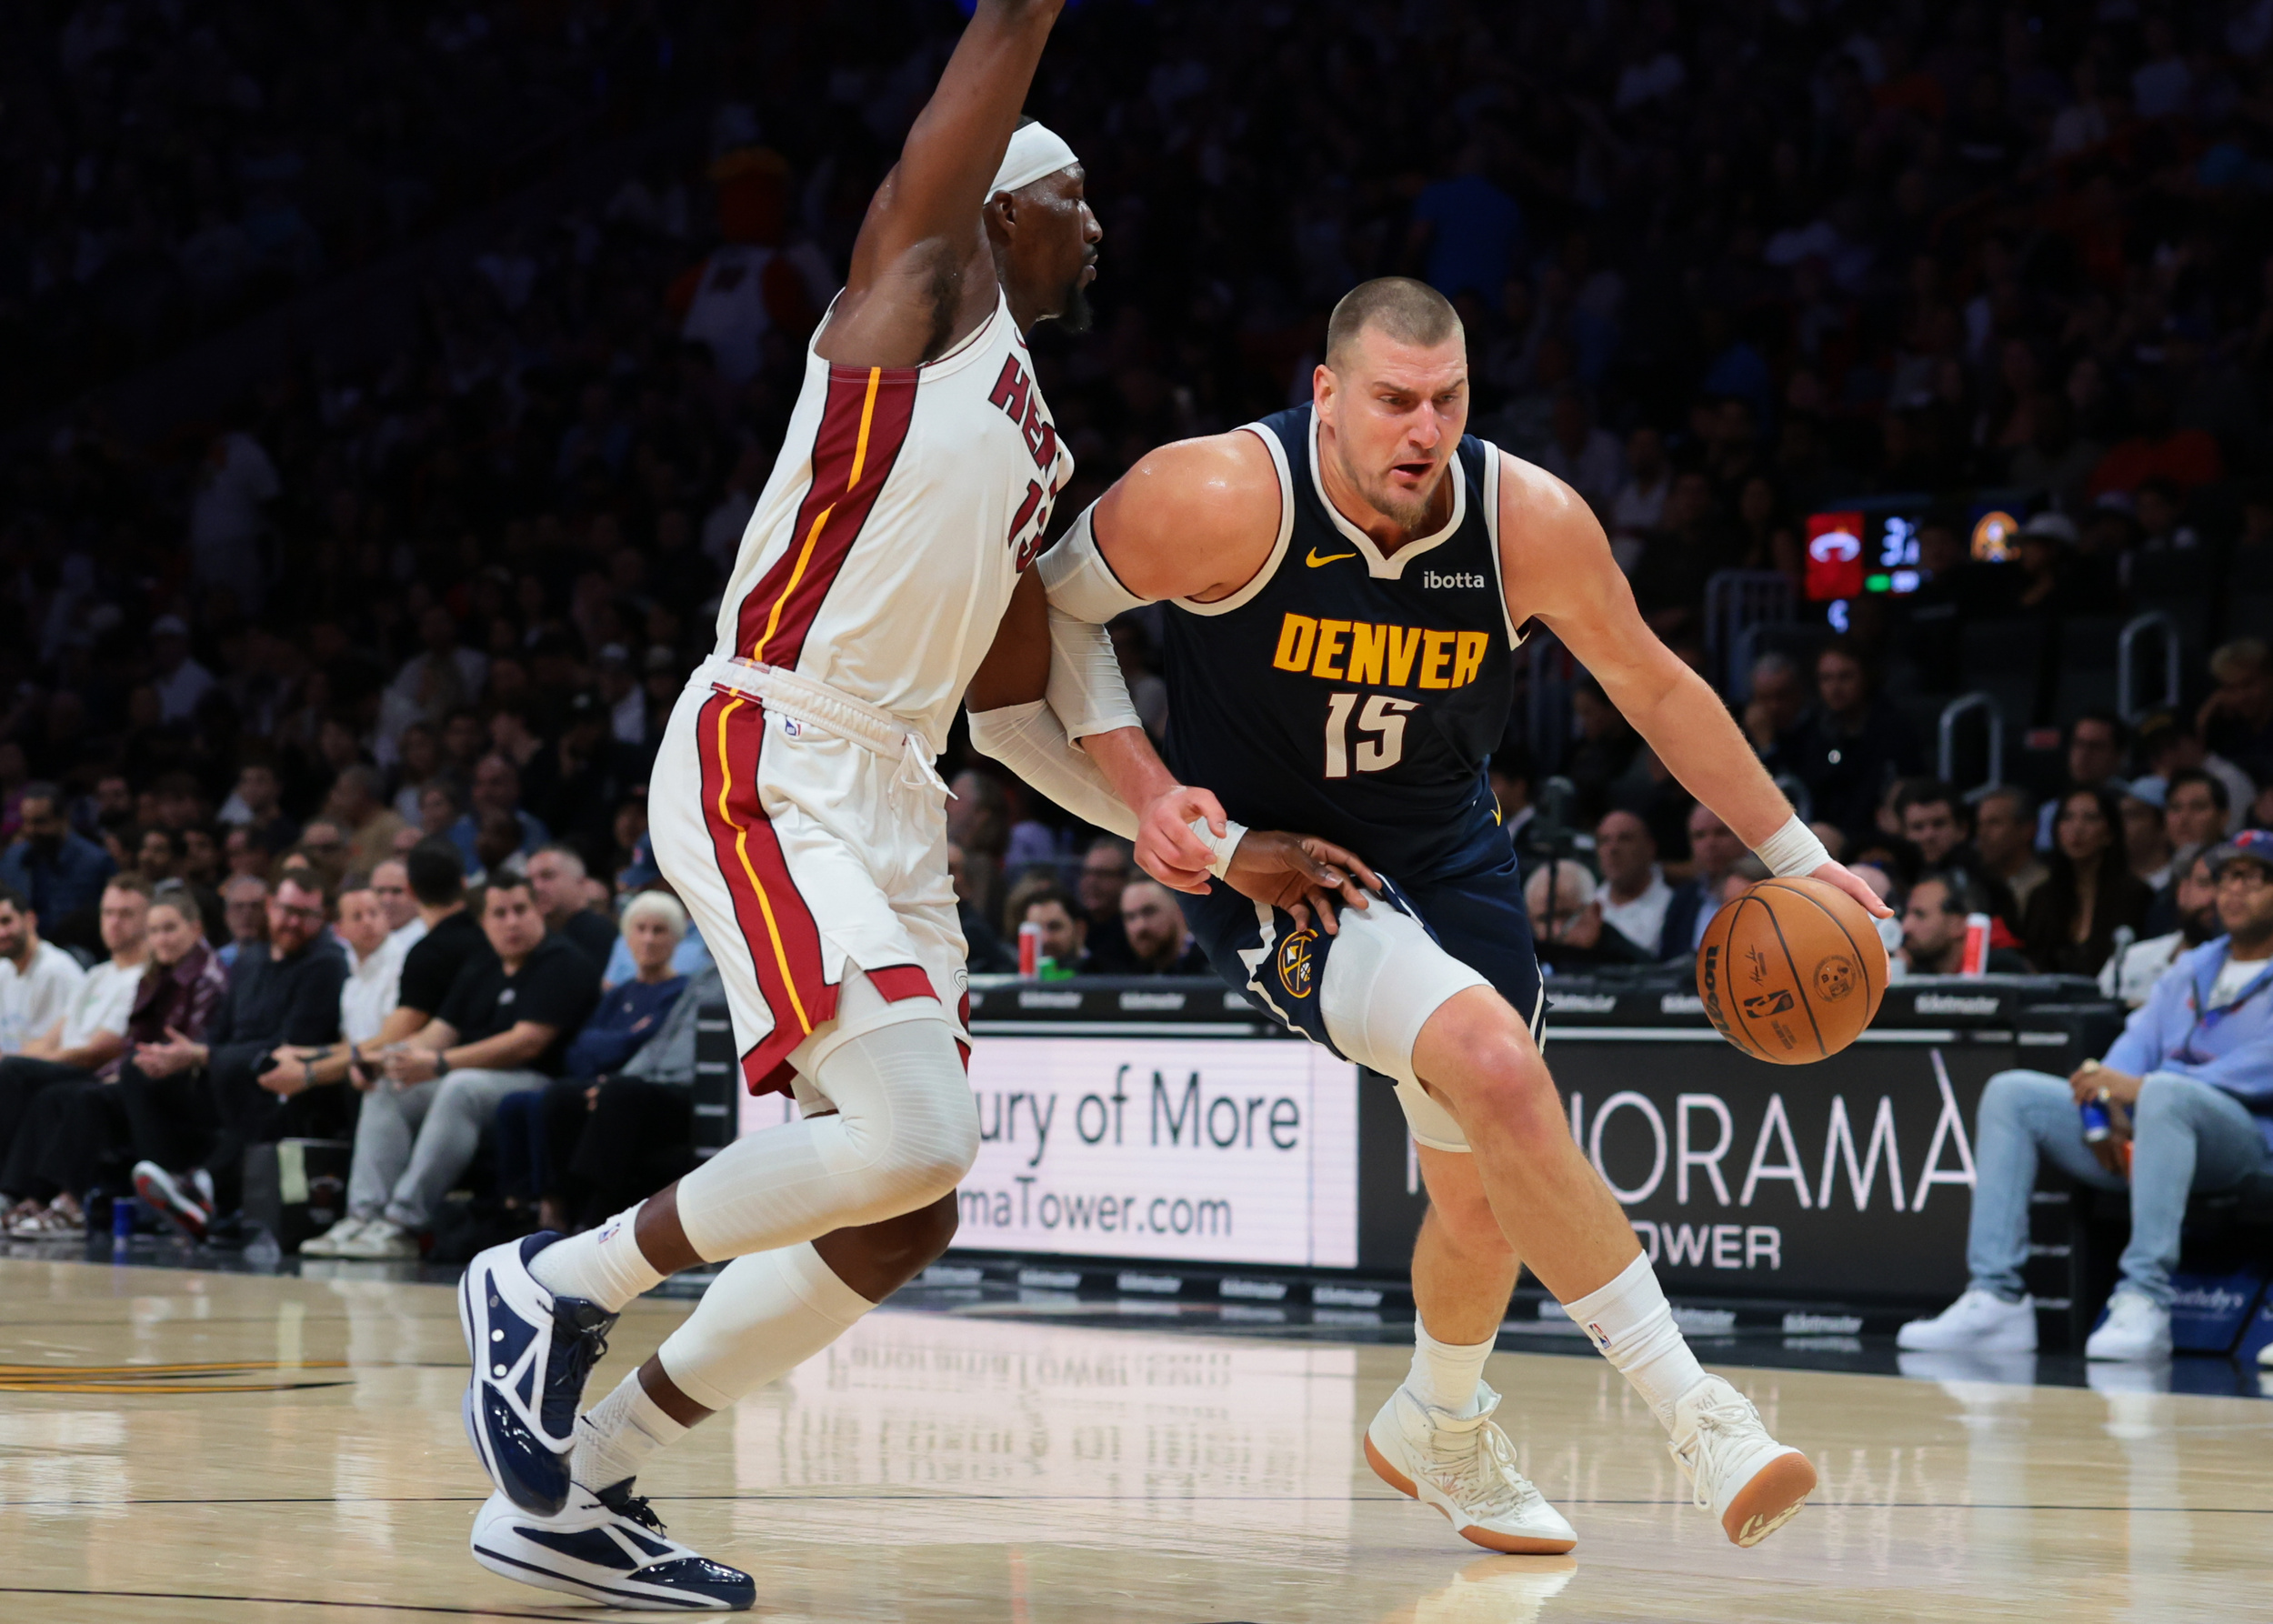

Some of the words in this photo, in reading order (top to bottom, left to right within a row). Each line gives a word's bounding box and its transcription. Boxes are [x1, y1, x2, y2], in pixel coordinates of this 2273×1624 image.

[988, 352, 1057, 501] HEA
[1423, 570, 1485, 588] ibotta
[1272, 612, 1489, 689] DENVER
[1325, 692, 1425, 778] 15
[975, 1093, 1056, 1167] ury
[1076, 1064, 1130, 1145] of
[1151, 1071, 1299, 1149] More
[1407, 1048, 1977, 1212] ORAMA
[959, 1176, 1232, 1235] maTower.com
[1630, 1219, 1781, 1269] OWER
